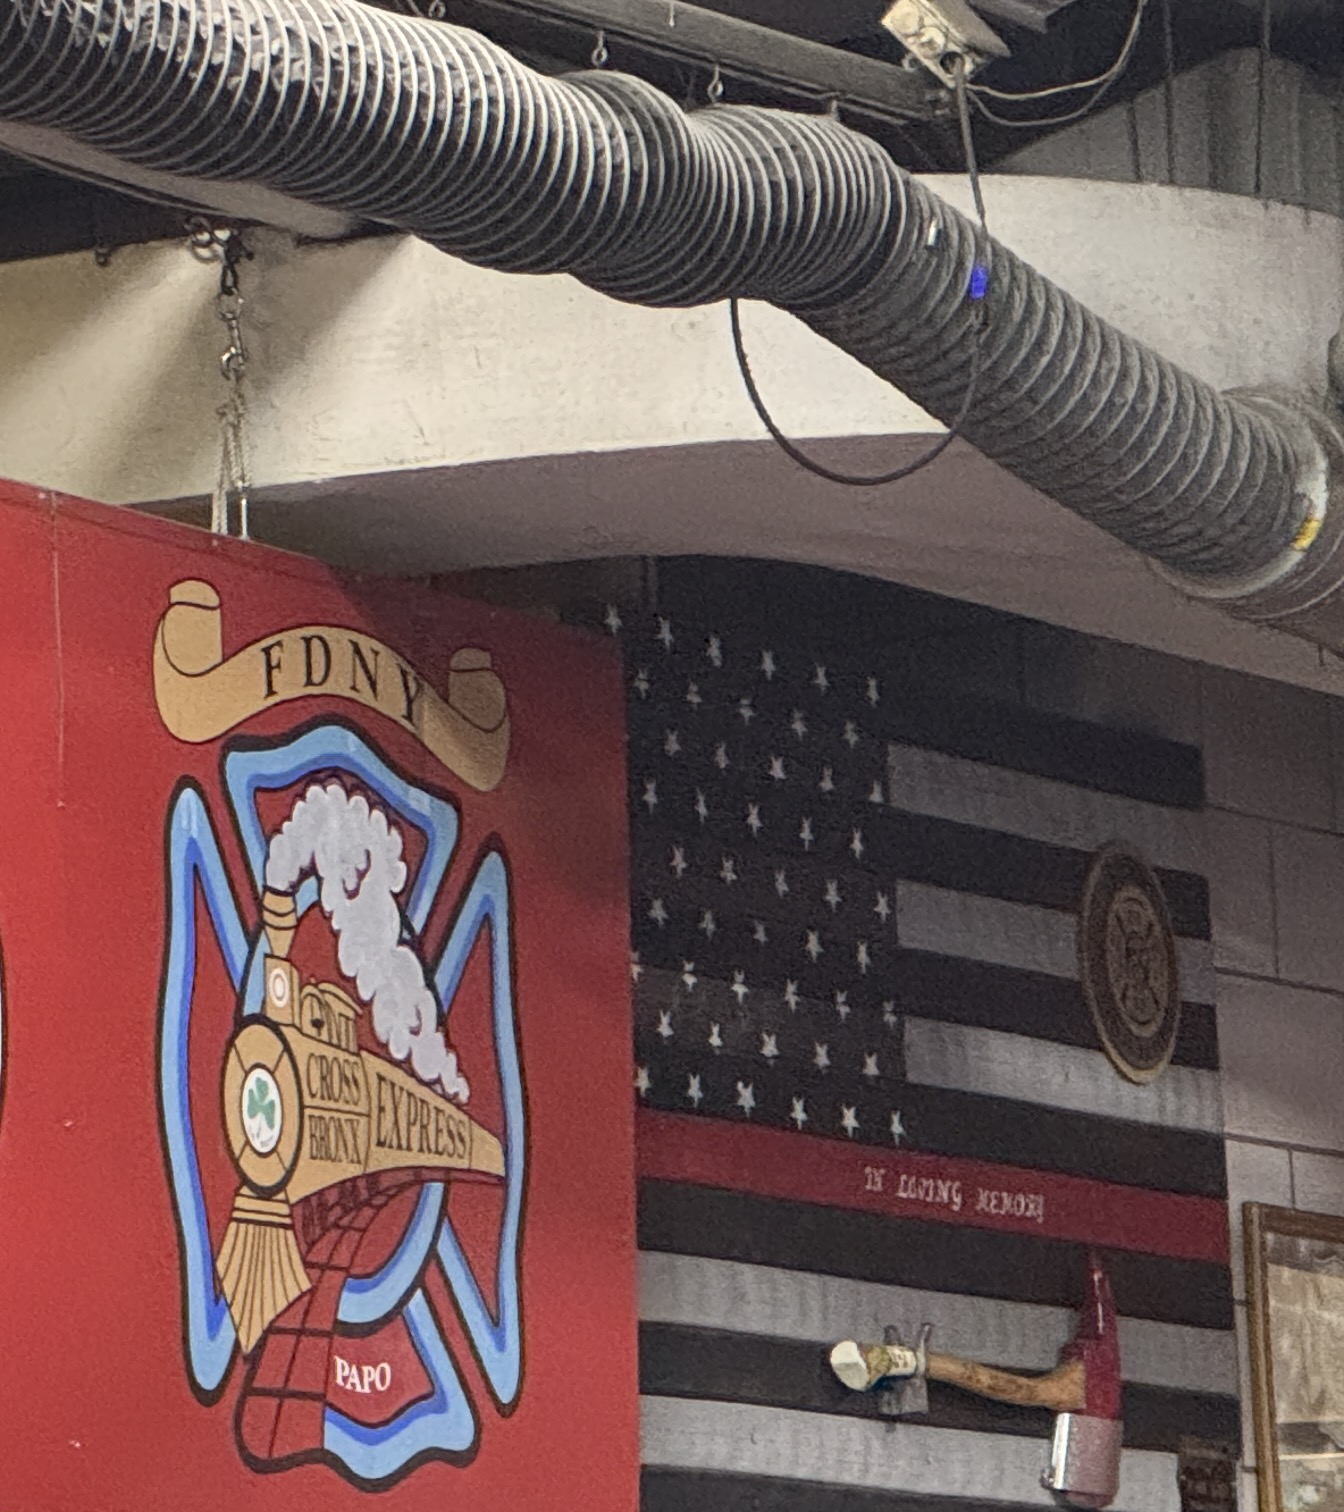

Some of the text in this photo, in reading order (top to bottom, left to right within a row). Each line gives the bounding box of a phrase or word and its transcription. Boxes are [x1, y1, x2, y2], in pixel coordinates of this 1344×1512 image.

[261, 634, 422, 724] FDNY
[305, 1050, 362, 1105] CROSS
[307, 1113, 363, 1166] BRONX
[375, 1068, 469, 1160] EXPRESS
[895, 1173, 963, 1212] LOVING
[974, 1187, 1045, 1224] MEMORY
[333, 1355, 391, 1395] PAPO
